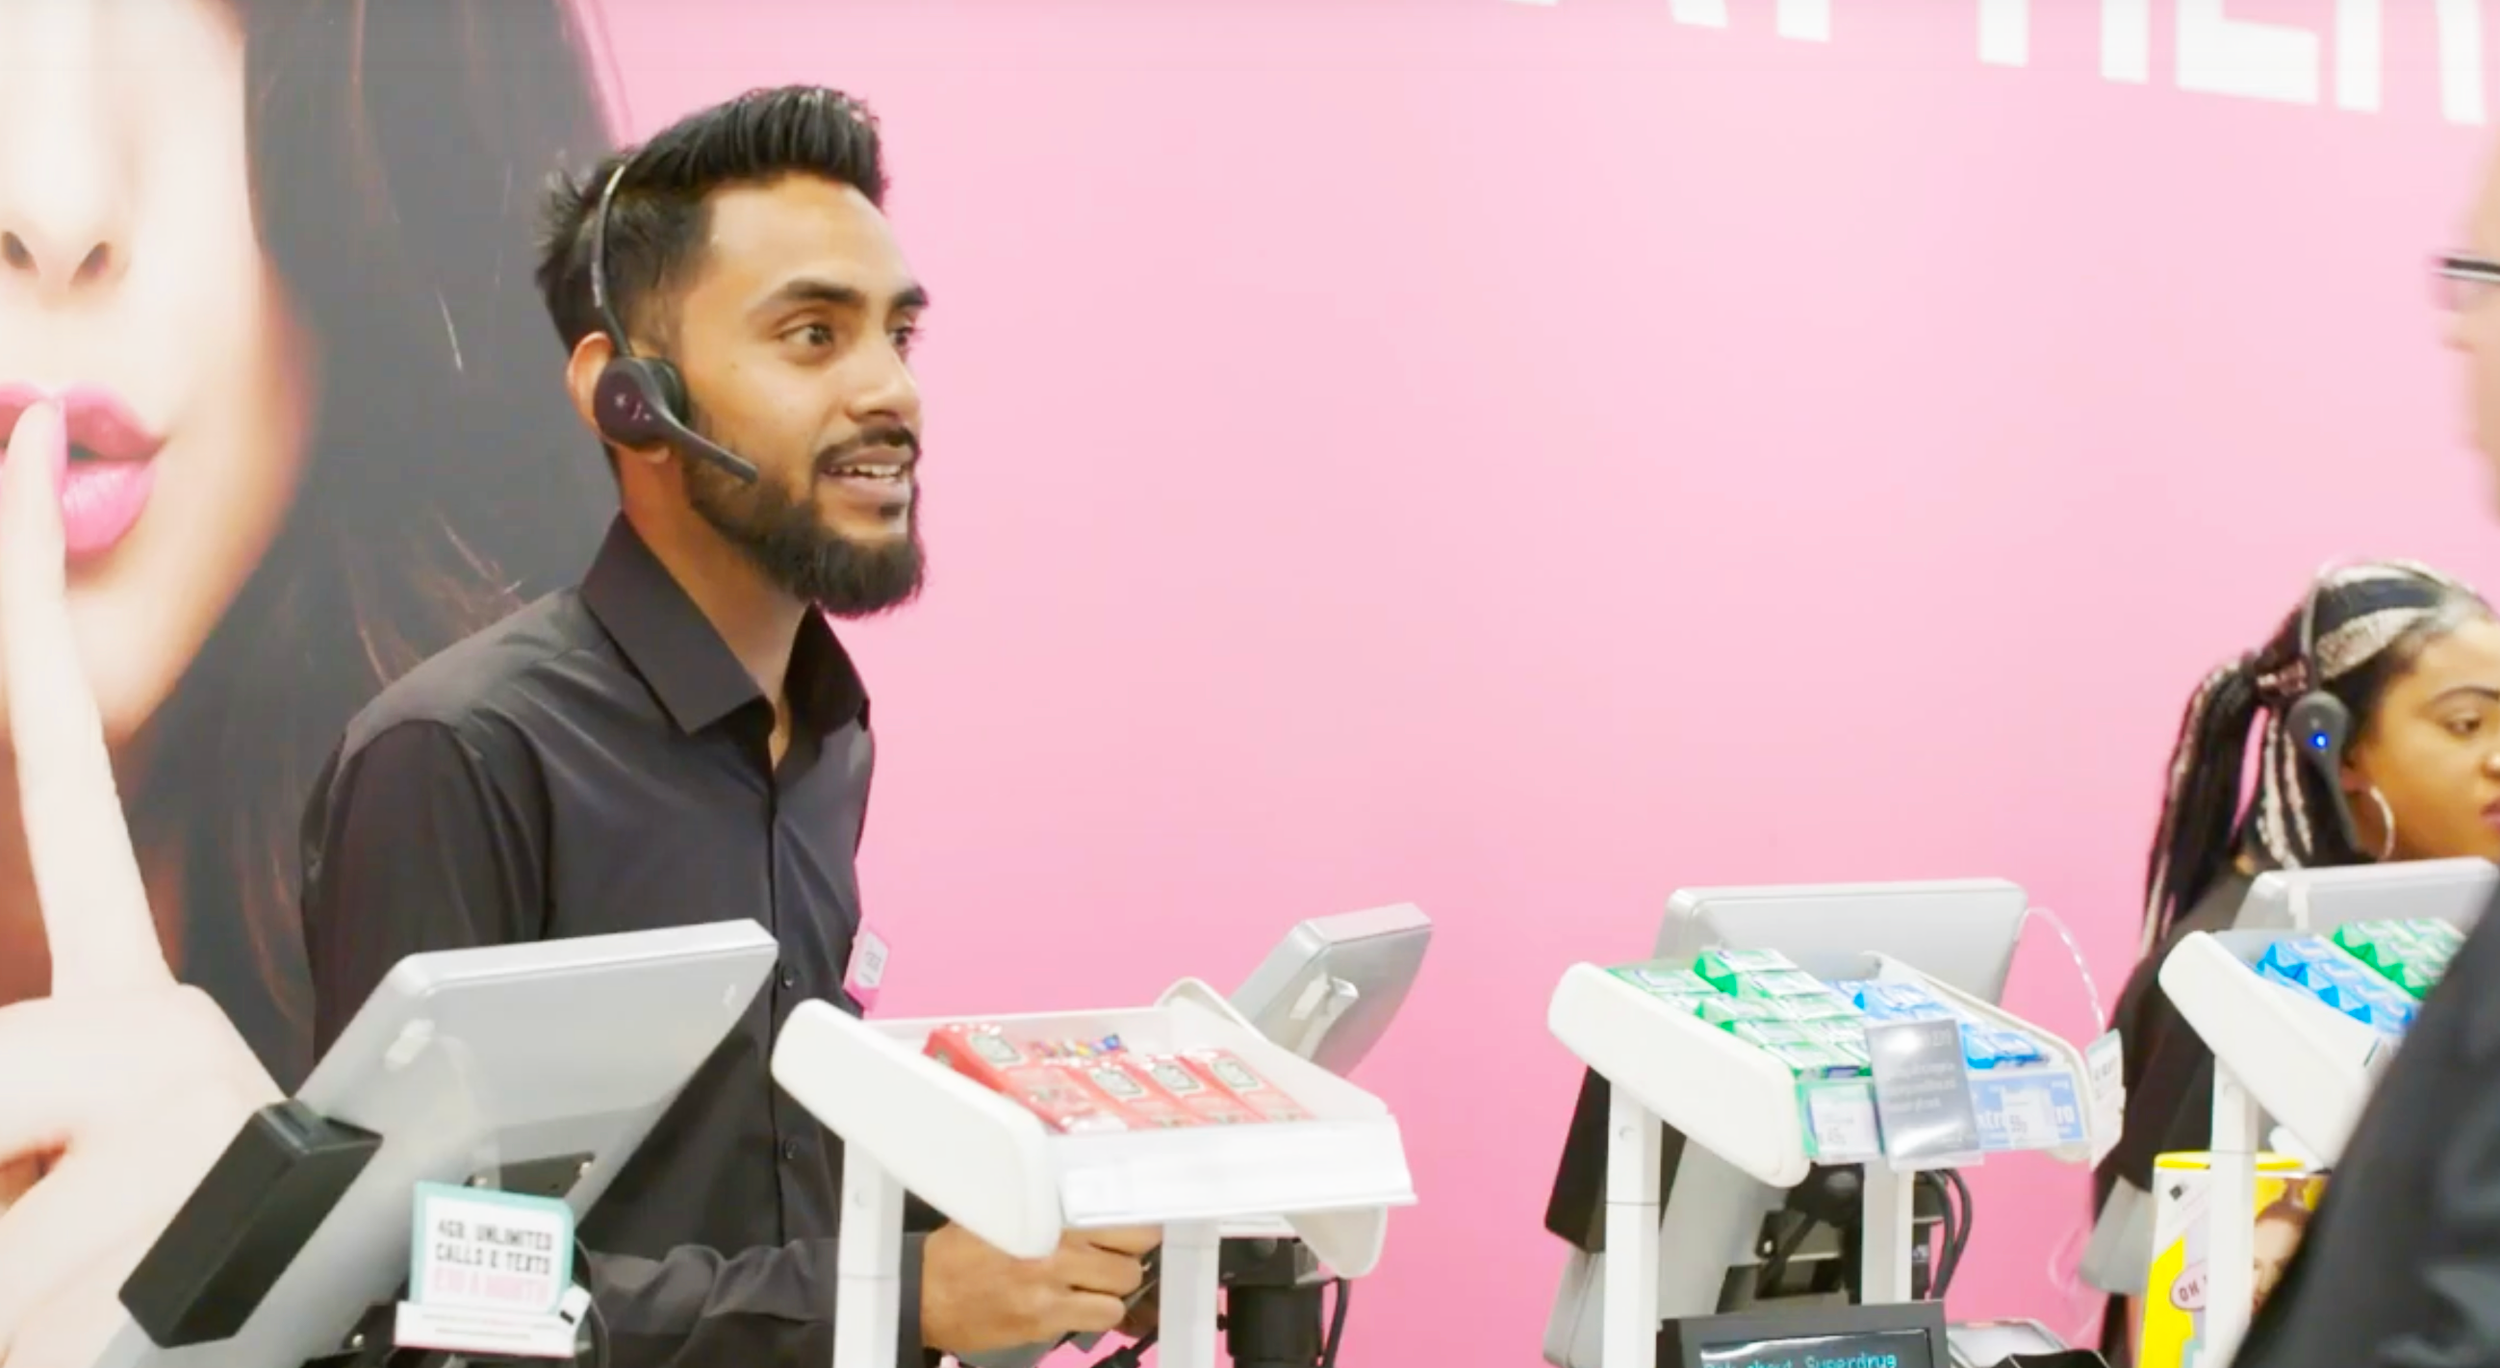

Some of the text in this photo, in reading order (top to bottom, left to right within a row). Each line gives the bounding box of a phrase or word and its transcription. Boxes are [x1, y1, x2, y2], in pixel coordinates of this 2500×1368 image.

[476, 1223, 552, 1251] UNLIMITED
[435, 1242, 484, 1267] CALLS
[505, 1250, 550, 1276] TEXTS
